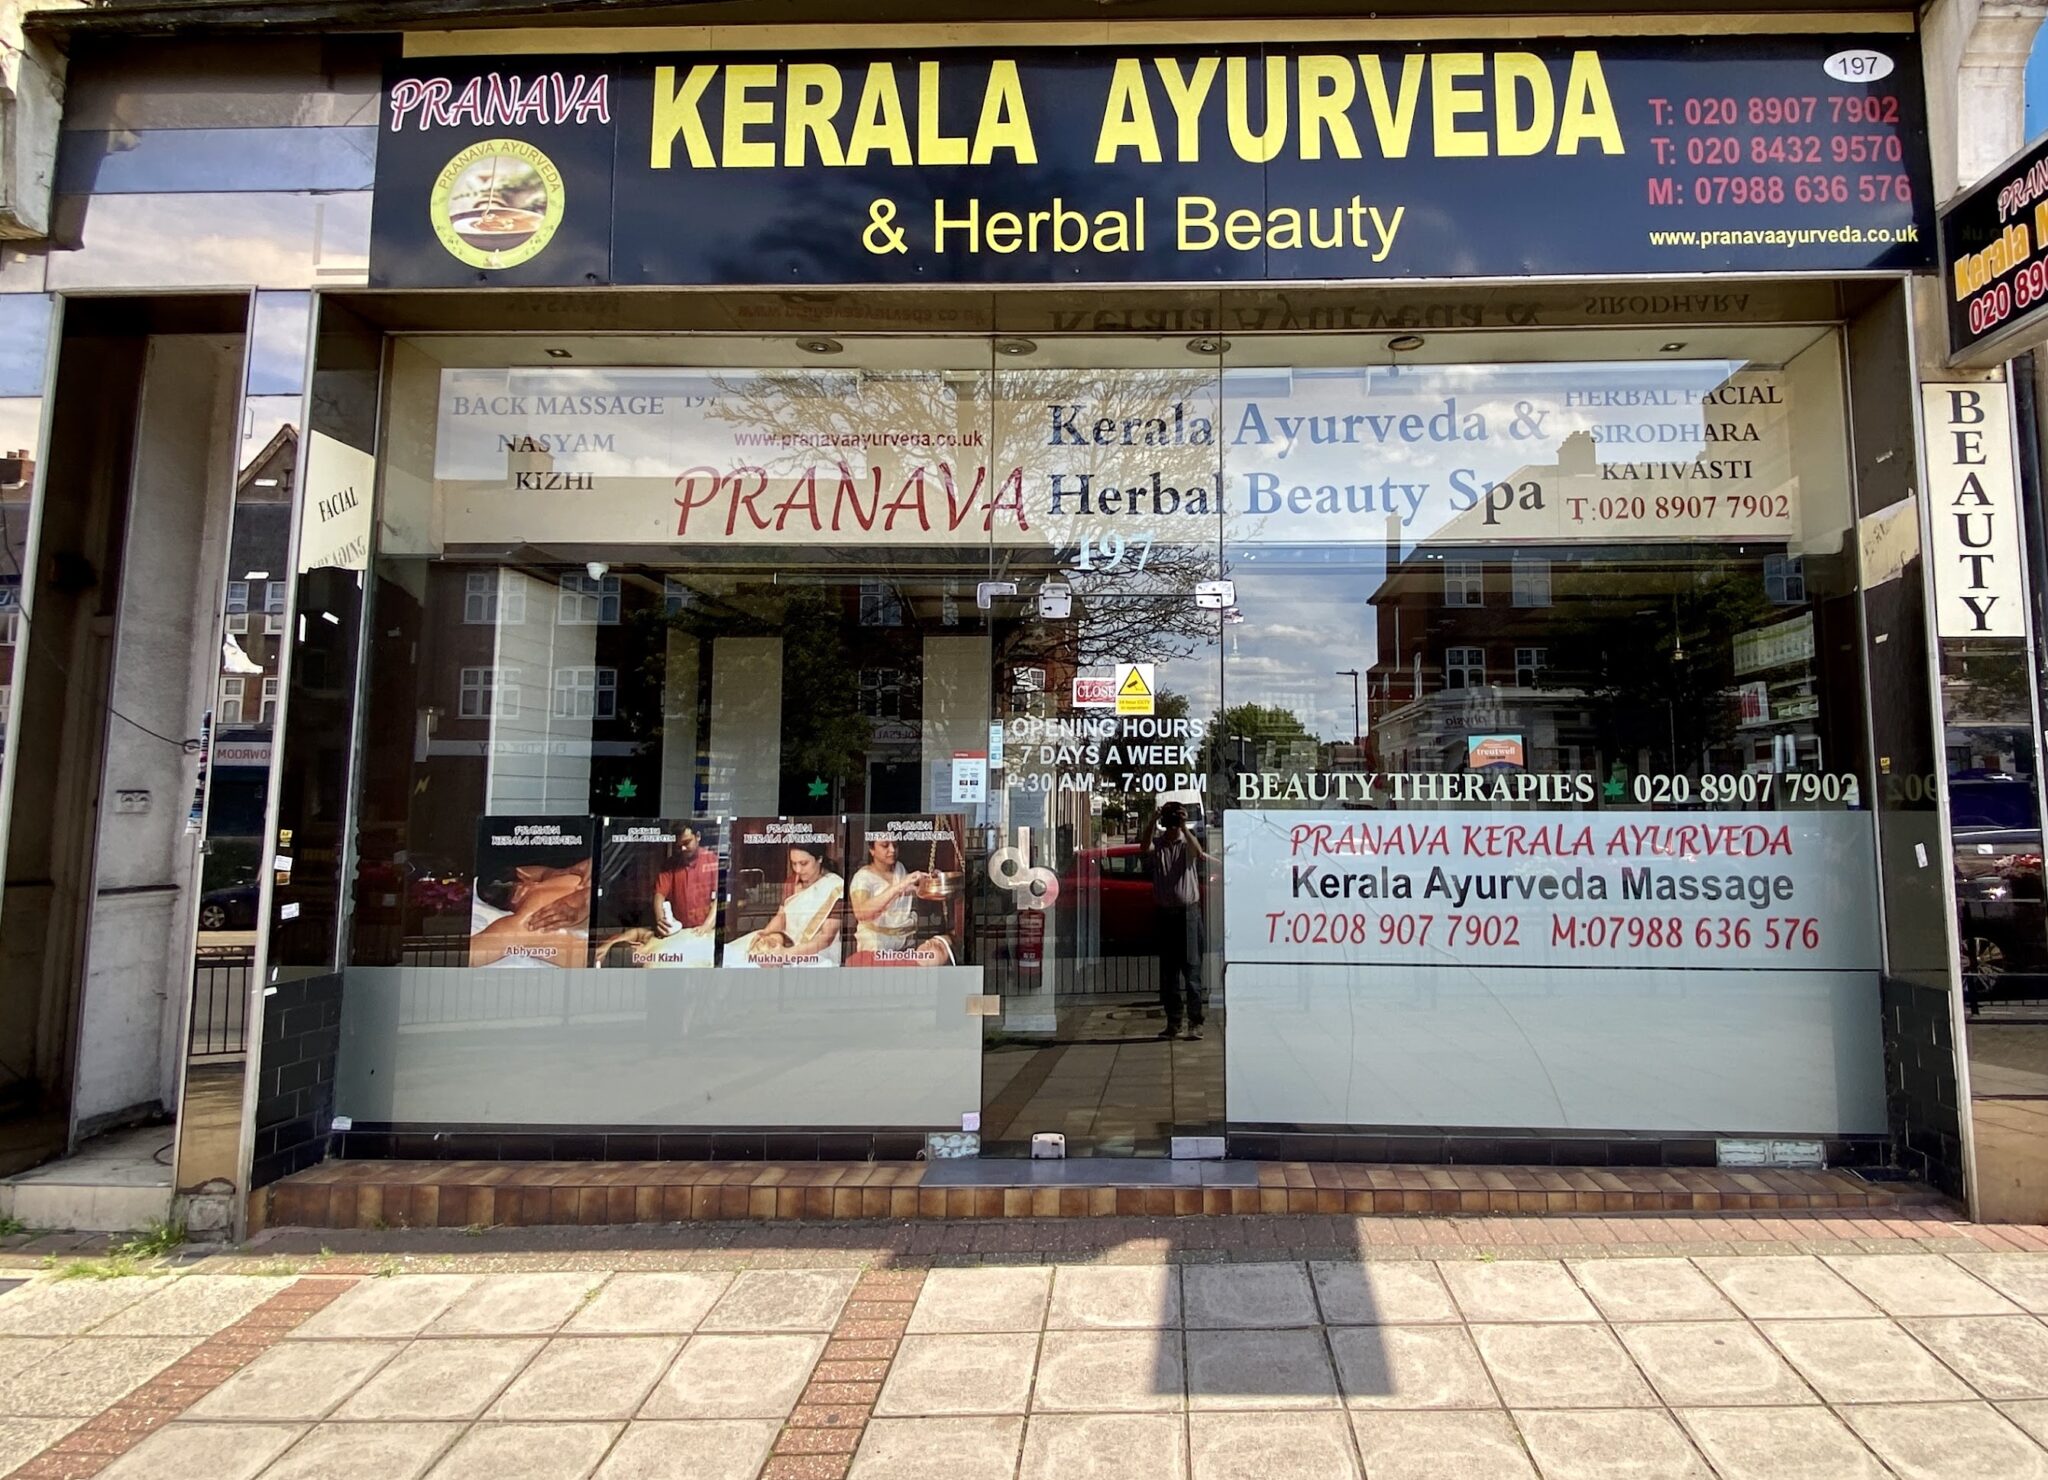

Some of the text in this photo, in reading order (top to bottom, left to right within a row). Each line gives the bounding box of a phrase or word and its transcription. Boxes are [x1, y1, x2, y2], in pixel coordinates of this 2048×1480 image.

[1837, 56, 1878, 76] 197
[391, 72, 610, 131] PRANAVA
[650, 50, 1625, 169] KERALA AYURVEDA
[1648, 96, 1899, 125] T: 020 8907 7902
[1651, 135, 1902, 165] T: 020 8432 9570
[439, 141, 561, 193] PRANAVA AYURVEDA
[1648, 175, 1912, 205] M: 07988 636 576
[862, 195, 1405, 262] & Herbal Beauty
[1649, 225, 1918, 249] www.pranavaayurveda.co.uk
[1954, 223, 2031, 302] Kerala
[1969, 281, 2011, 335] 020
[453, 395, 528, 416] BACK
[535, 395, 664, 416] MASSAGE
[1564, 385, 1783, 410] HERBAL FACIAL
[1048, 397, 1550, 459] Kerala Ayurveda &
[1590, 422, 1760, 444] SIRODHARA
[496, 433, 615, 454] NASYAM
[1602, 459, 1752, 481] KATIVASTI
[318, 486, 359, 523] FACIAL
[674, 460, 1031, 537] PRANAVA
[1048, 468, 1546, 526] Herbal Beauty Spa
[1567, 495, 1790, 525] T:020 8907 7902
[1947, 389, 2000, 632] BEAUTY
[1074, 532, 1154, 572] 197
[1012, 717, 1204, 738] OPENING HOURS
[1020, 745, 1196, 765] 7 DAYS A WEEK
[1058, 772, 1093, 792] AM
[1122, 772, 1167, 792] 7:00
[1174, 772, 1208, 792] PM
[1236, 773, 1858, 803] BEAUTY THERAPIES 020 8907 7902
[1290, 823, 1794, 857] PRANAVA KERALA AYURVEDA
[1291, 866, 1794, 910] Kerala Ayurveda Massage
[1265, 912, 1820, 949] T:0208 907 7902 M:07988 636 576
[505, 946, 558, 958] Abhyanga
[632, 953, 684, 964] Podi Kizhi
[748, 953, 819, 965] Mukha Lepam
[874, 949, 935, 961] Shirodhara
